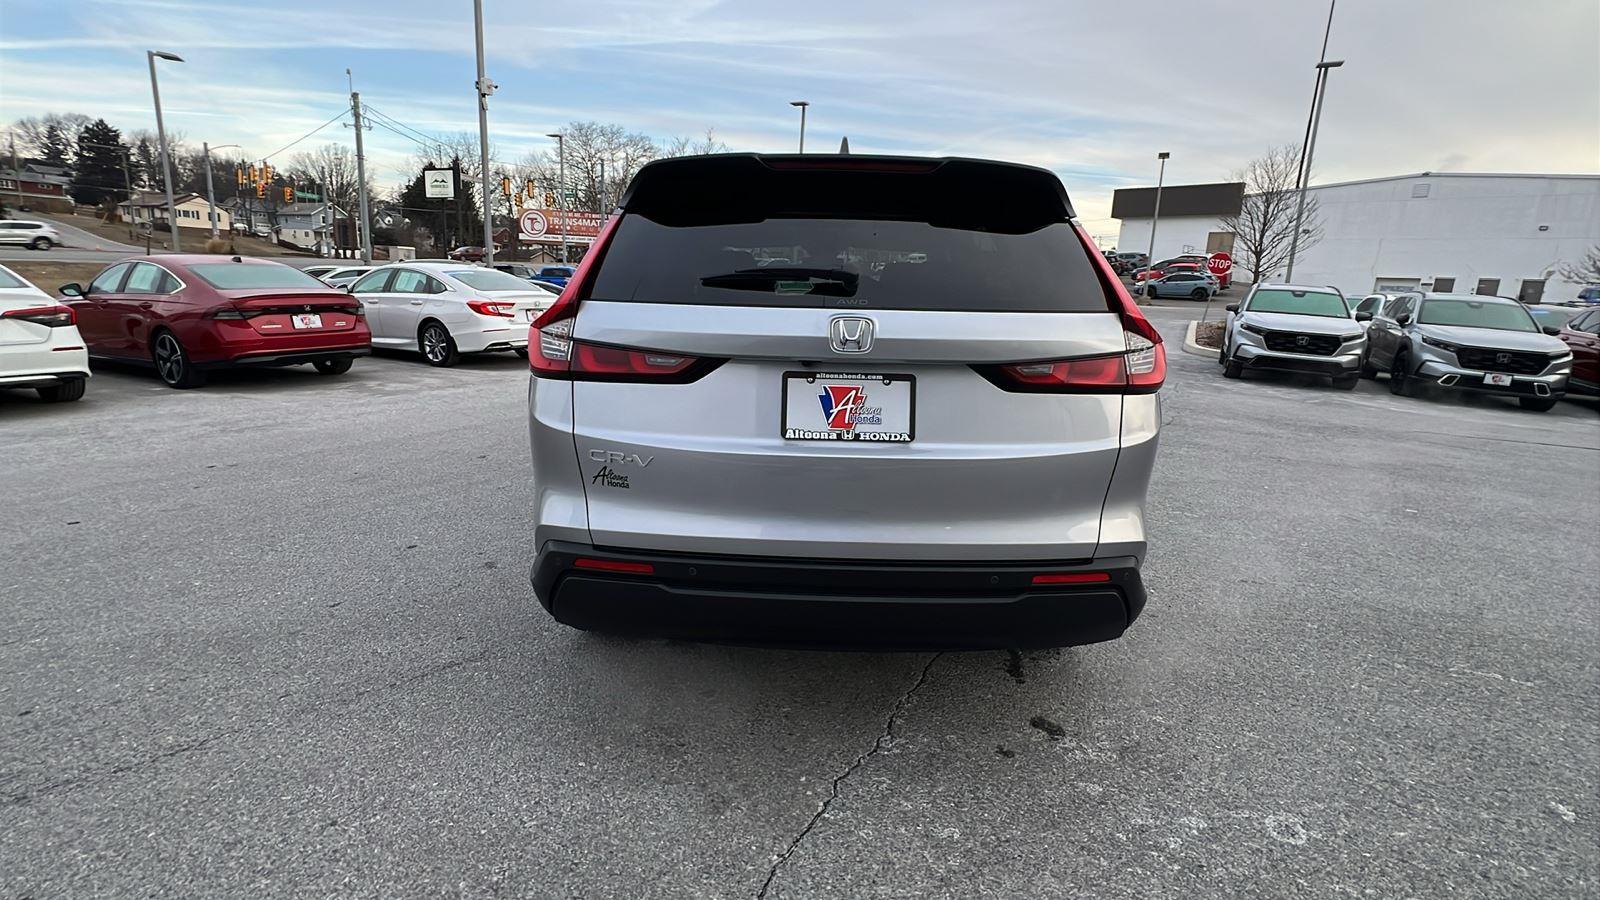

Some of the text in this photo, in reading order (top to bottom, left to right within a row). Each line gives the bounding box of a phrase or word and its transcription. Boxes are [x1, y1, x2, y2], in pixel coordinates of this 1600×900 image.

[549, 217, 608, 226] TRANS4MAT
[1208, 258, 1231, 268] STOP
[828, 389, 882, 424] Altoona
[849, 414, 881, 424] Honda
[785, 429, 911, 441] Altoona HONDA
[590, 449, 654, 468] CR-V
[592, 465, 629, 486] Altoona
[607, 480, 630, 489] Honda
